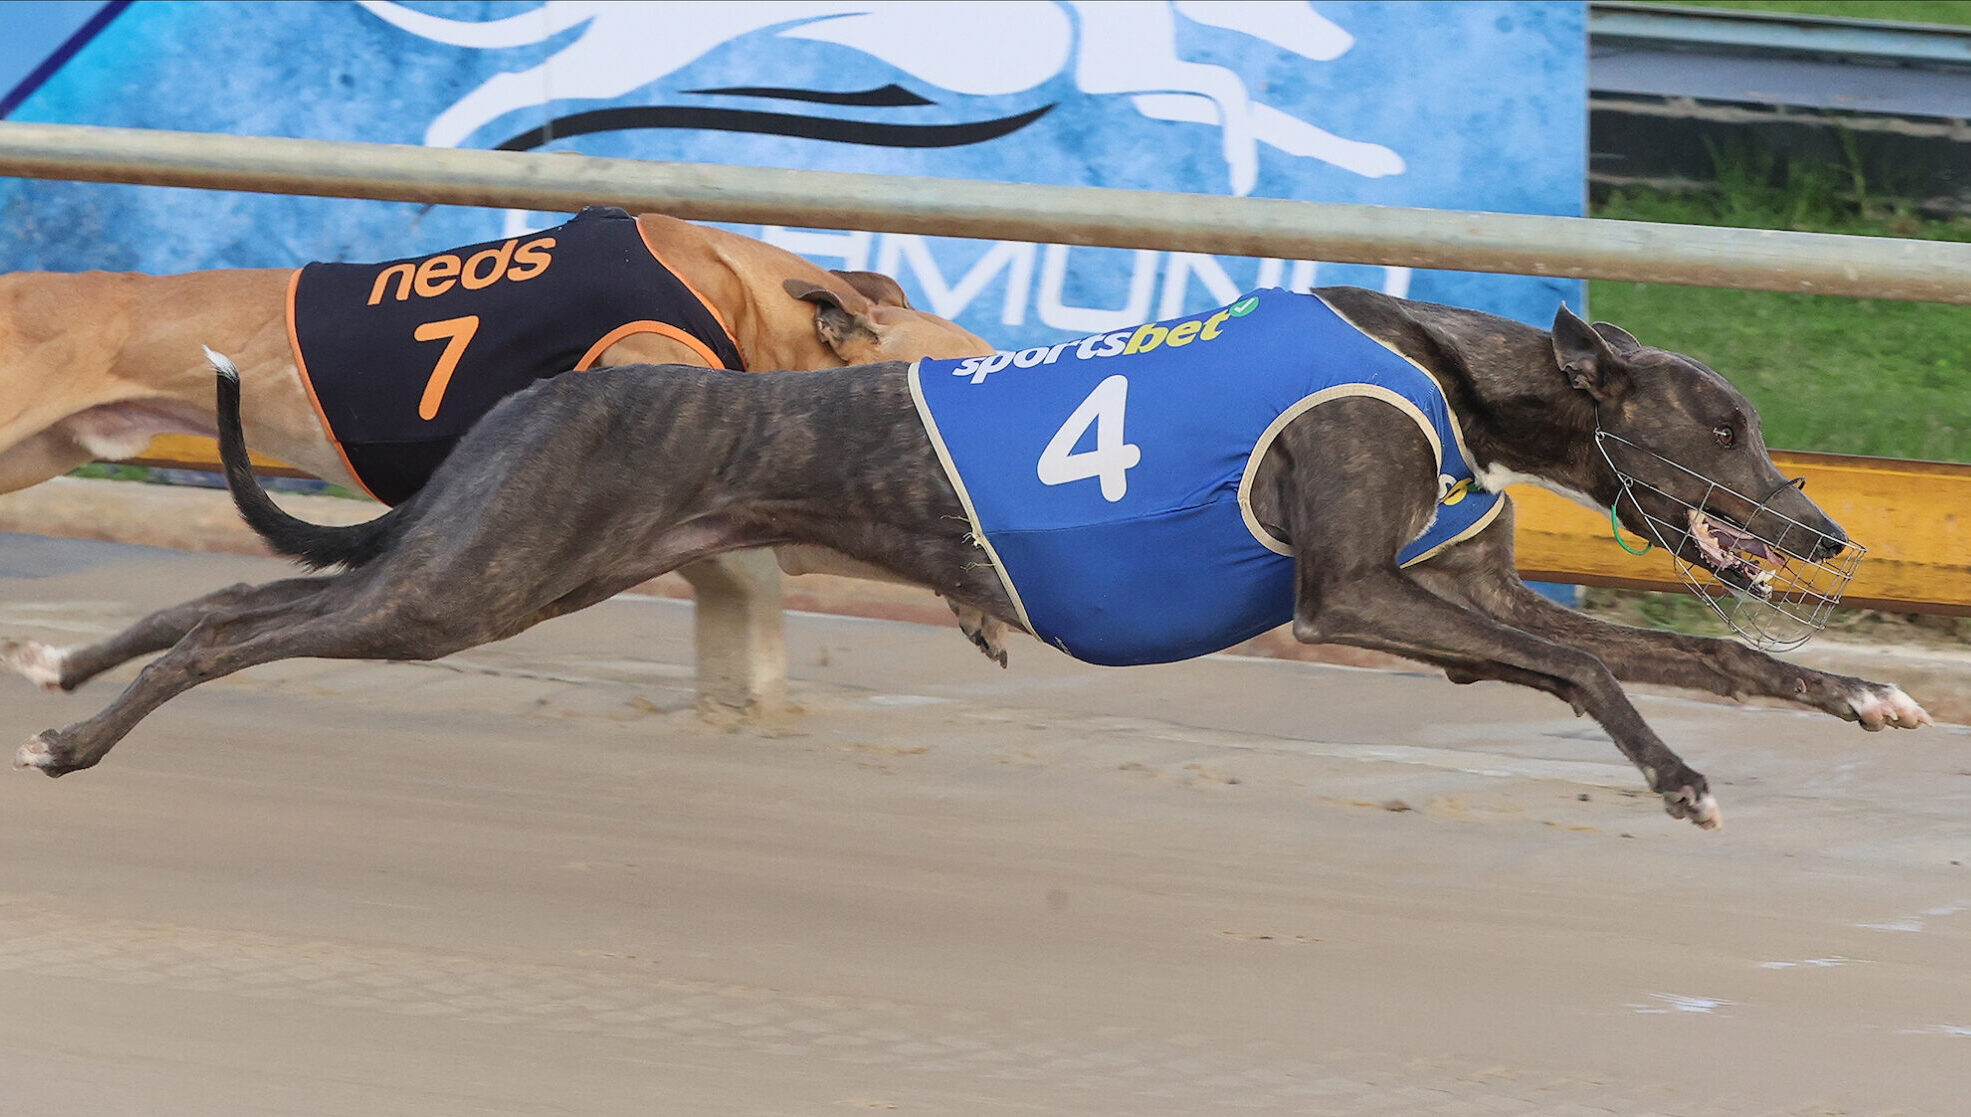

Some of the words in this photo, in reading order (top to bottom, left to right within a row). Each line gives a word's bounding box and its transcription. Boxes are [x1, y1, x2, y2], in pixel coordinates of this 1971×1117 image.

[367, 237, 556, 306] neds
[414, 315, 479, 421] 7
[952, 309, 1231, 384] sportsbet
[1037, 375, 1141, 502] 4
